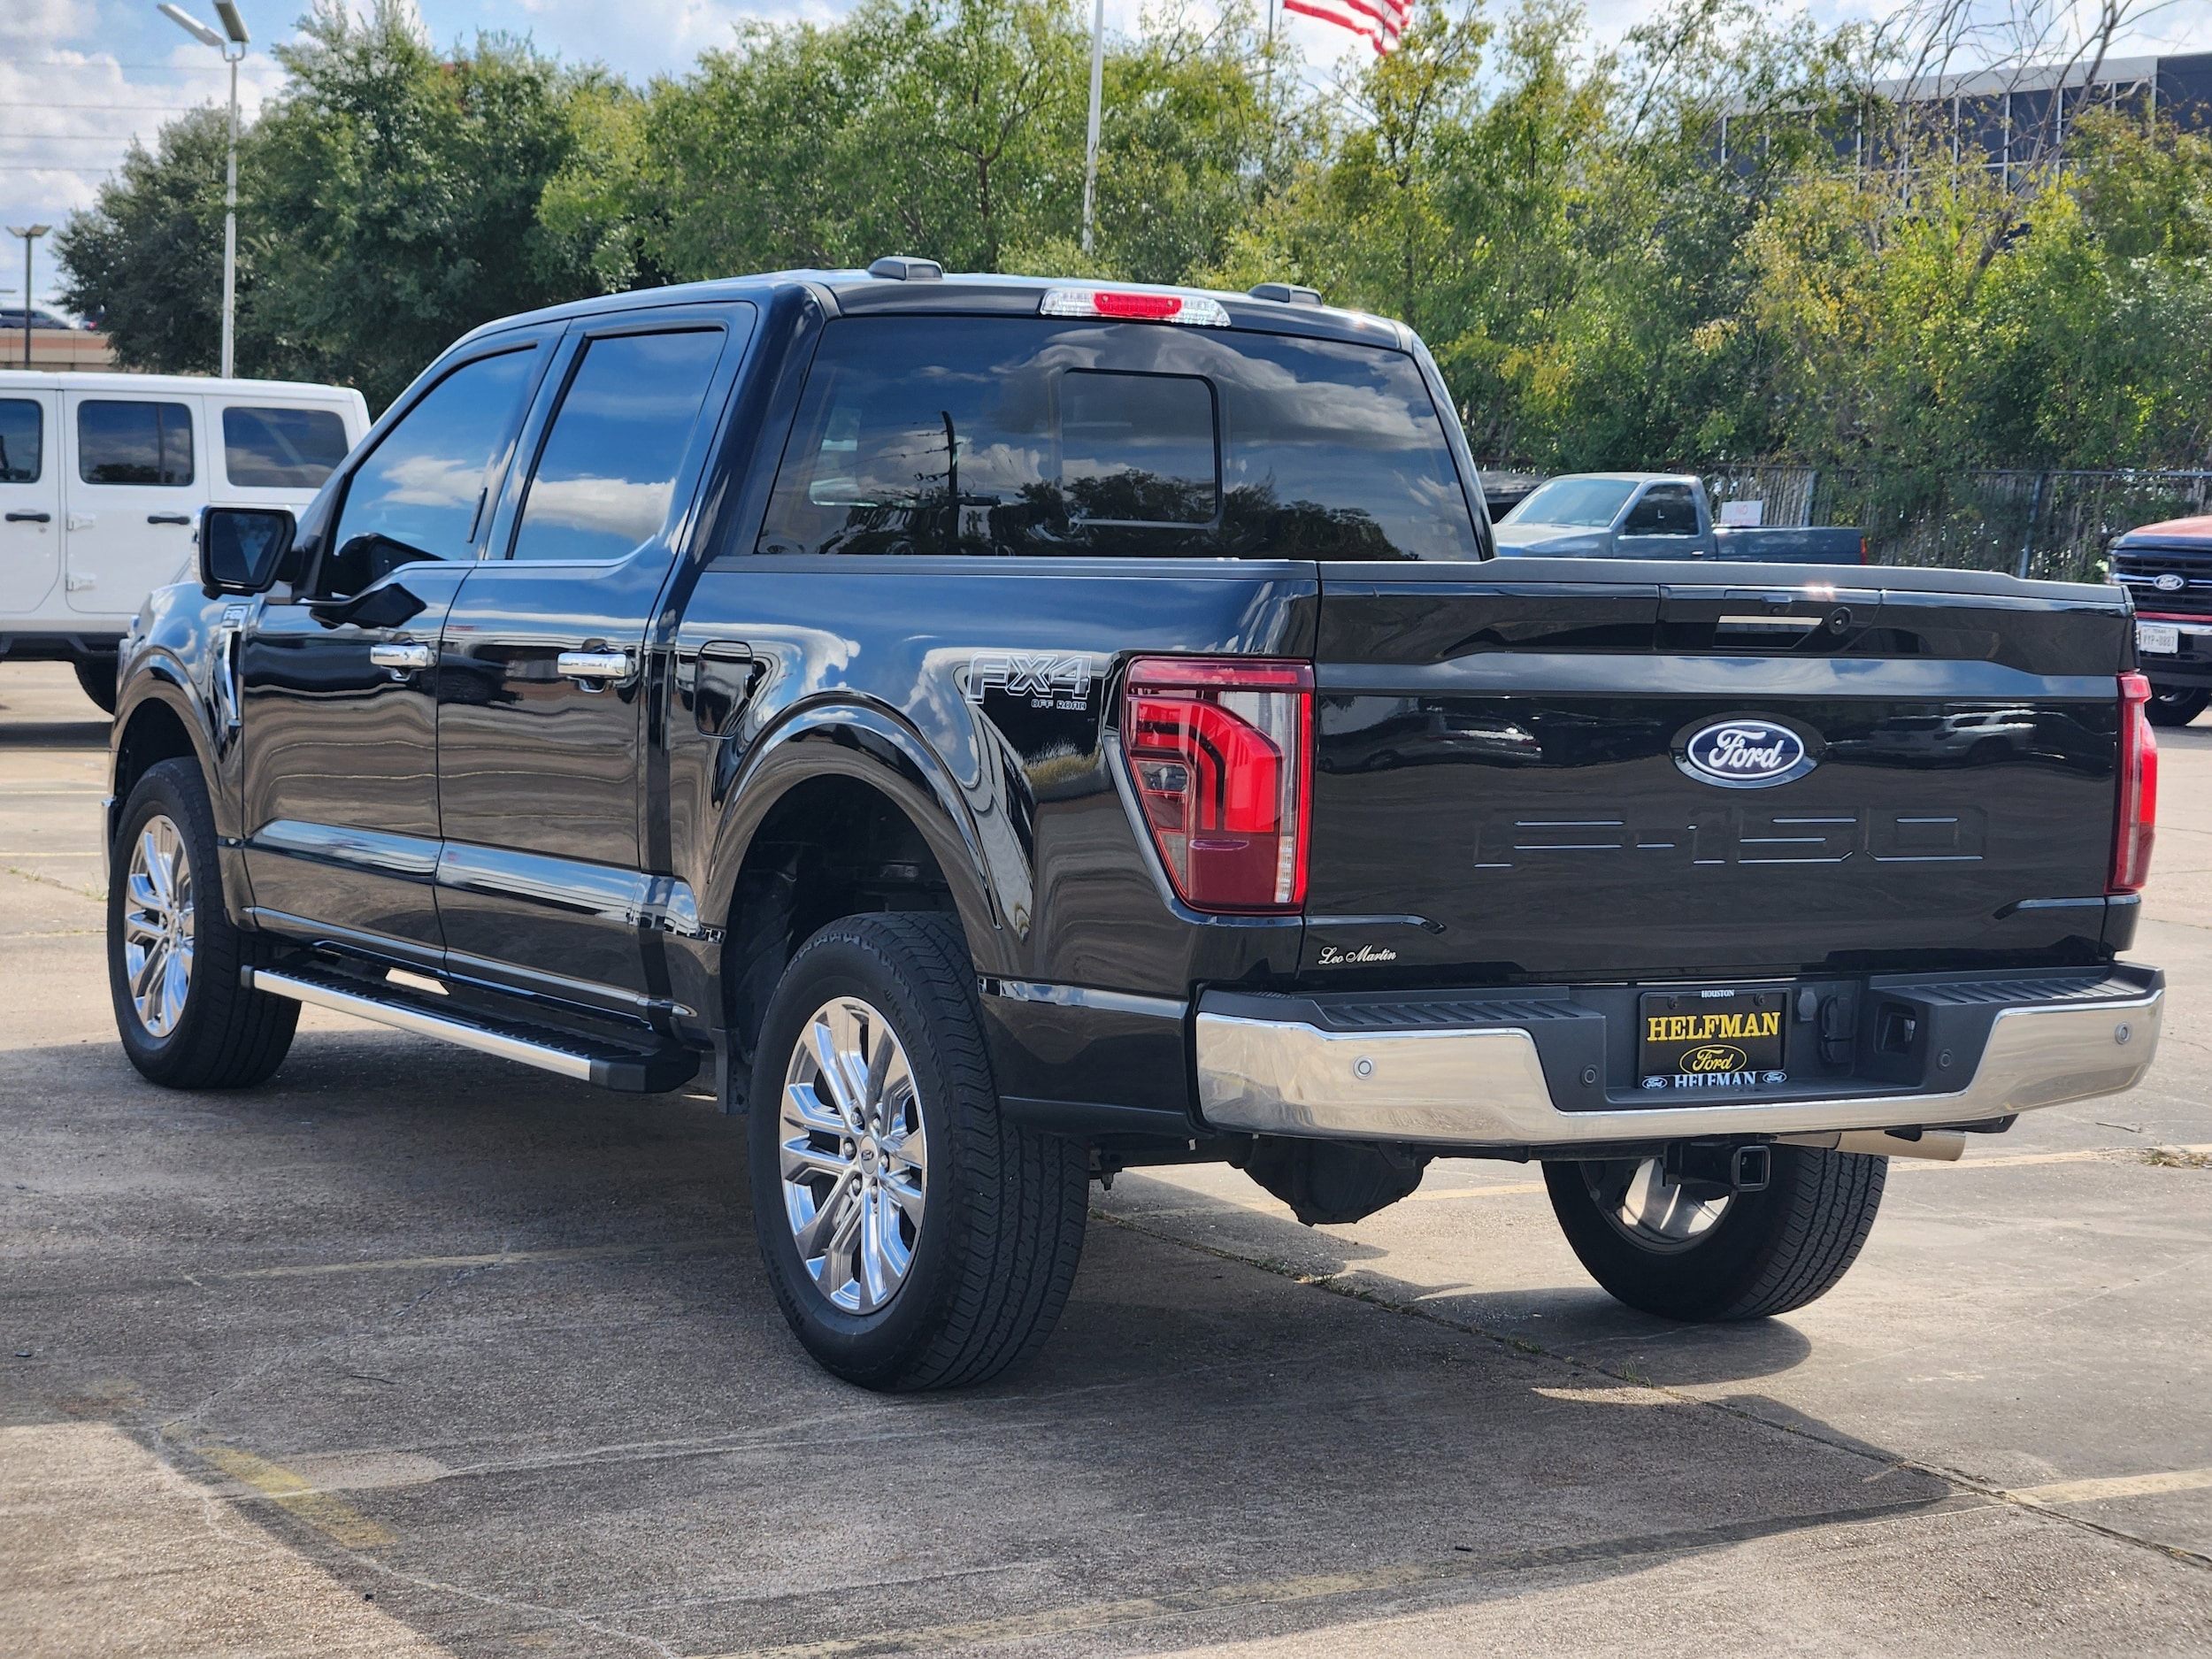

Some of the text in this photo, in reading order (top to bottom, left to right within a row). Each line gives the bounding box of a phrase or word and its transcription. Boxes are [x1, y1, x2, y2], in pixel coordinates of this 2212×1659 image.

[965, 651, 1092, 704] FX4
[1031, 698, 1087, 710] OFF ROAD
[1709, 729, 1785, 768] Ford
[1318, 944, 1396, 964] Leo Martin
[1701, 989, 1734, 998] HOUSTON
[1647, 1012, 1781, 1041] HELFMAN
[1692, 1048, 1734, 1071] Ford
